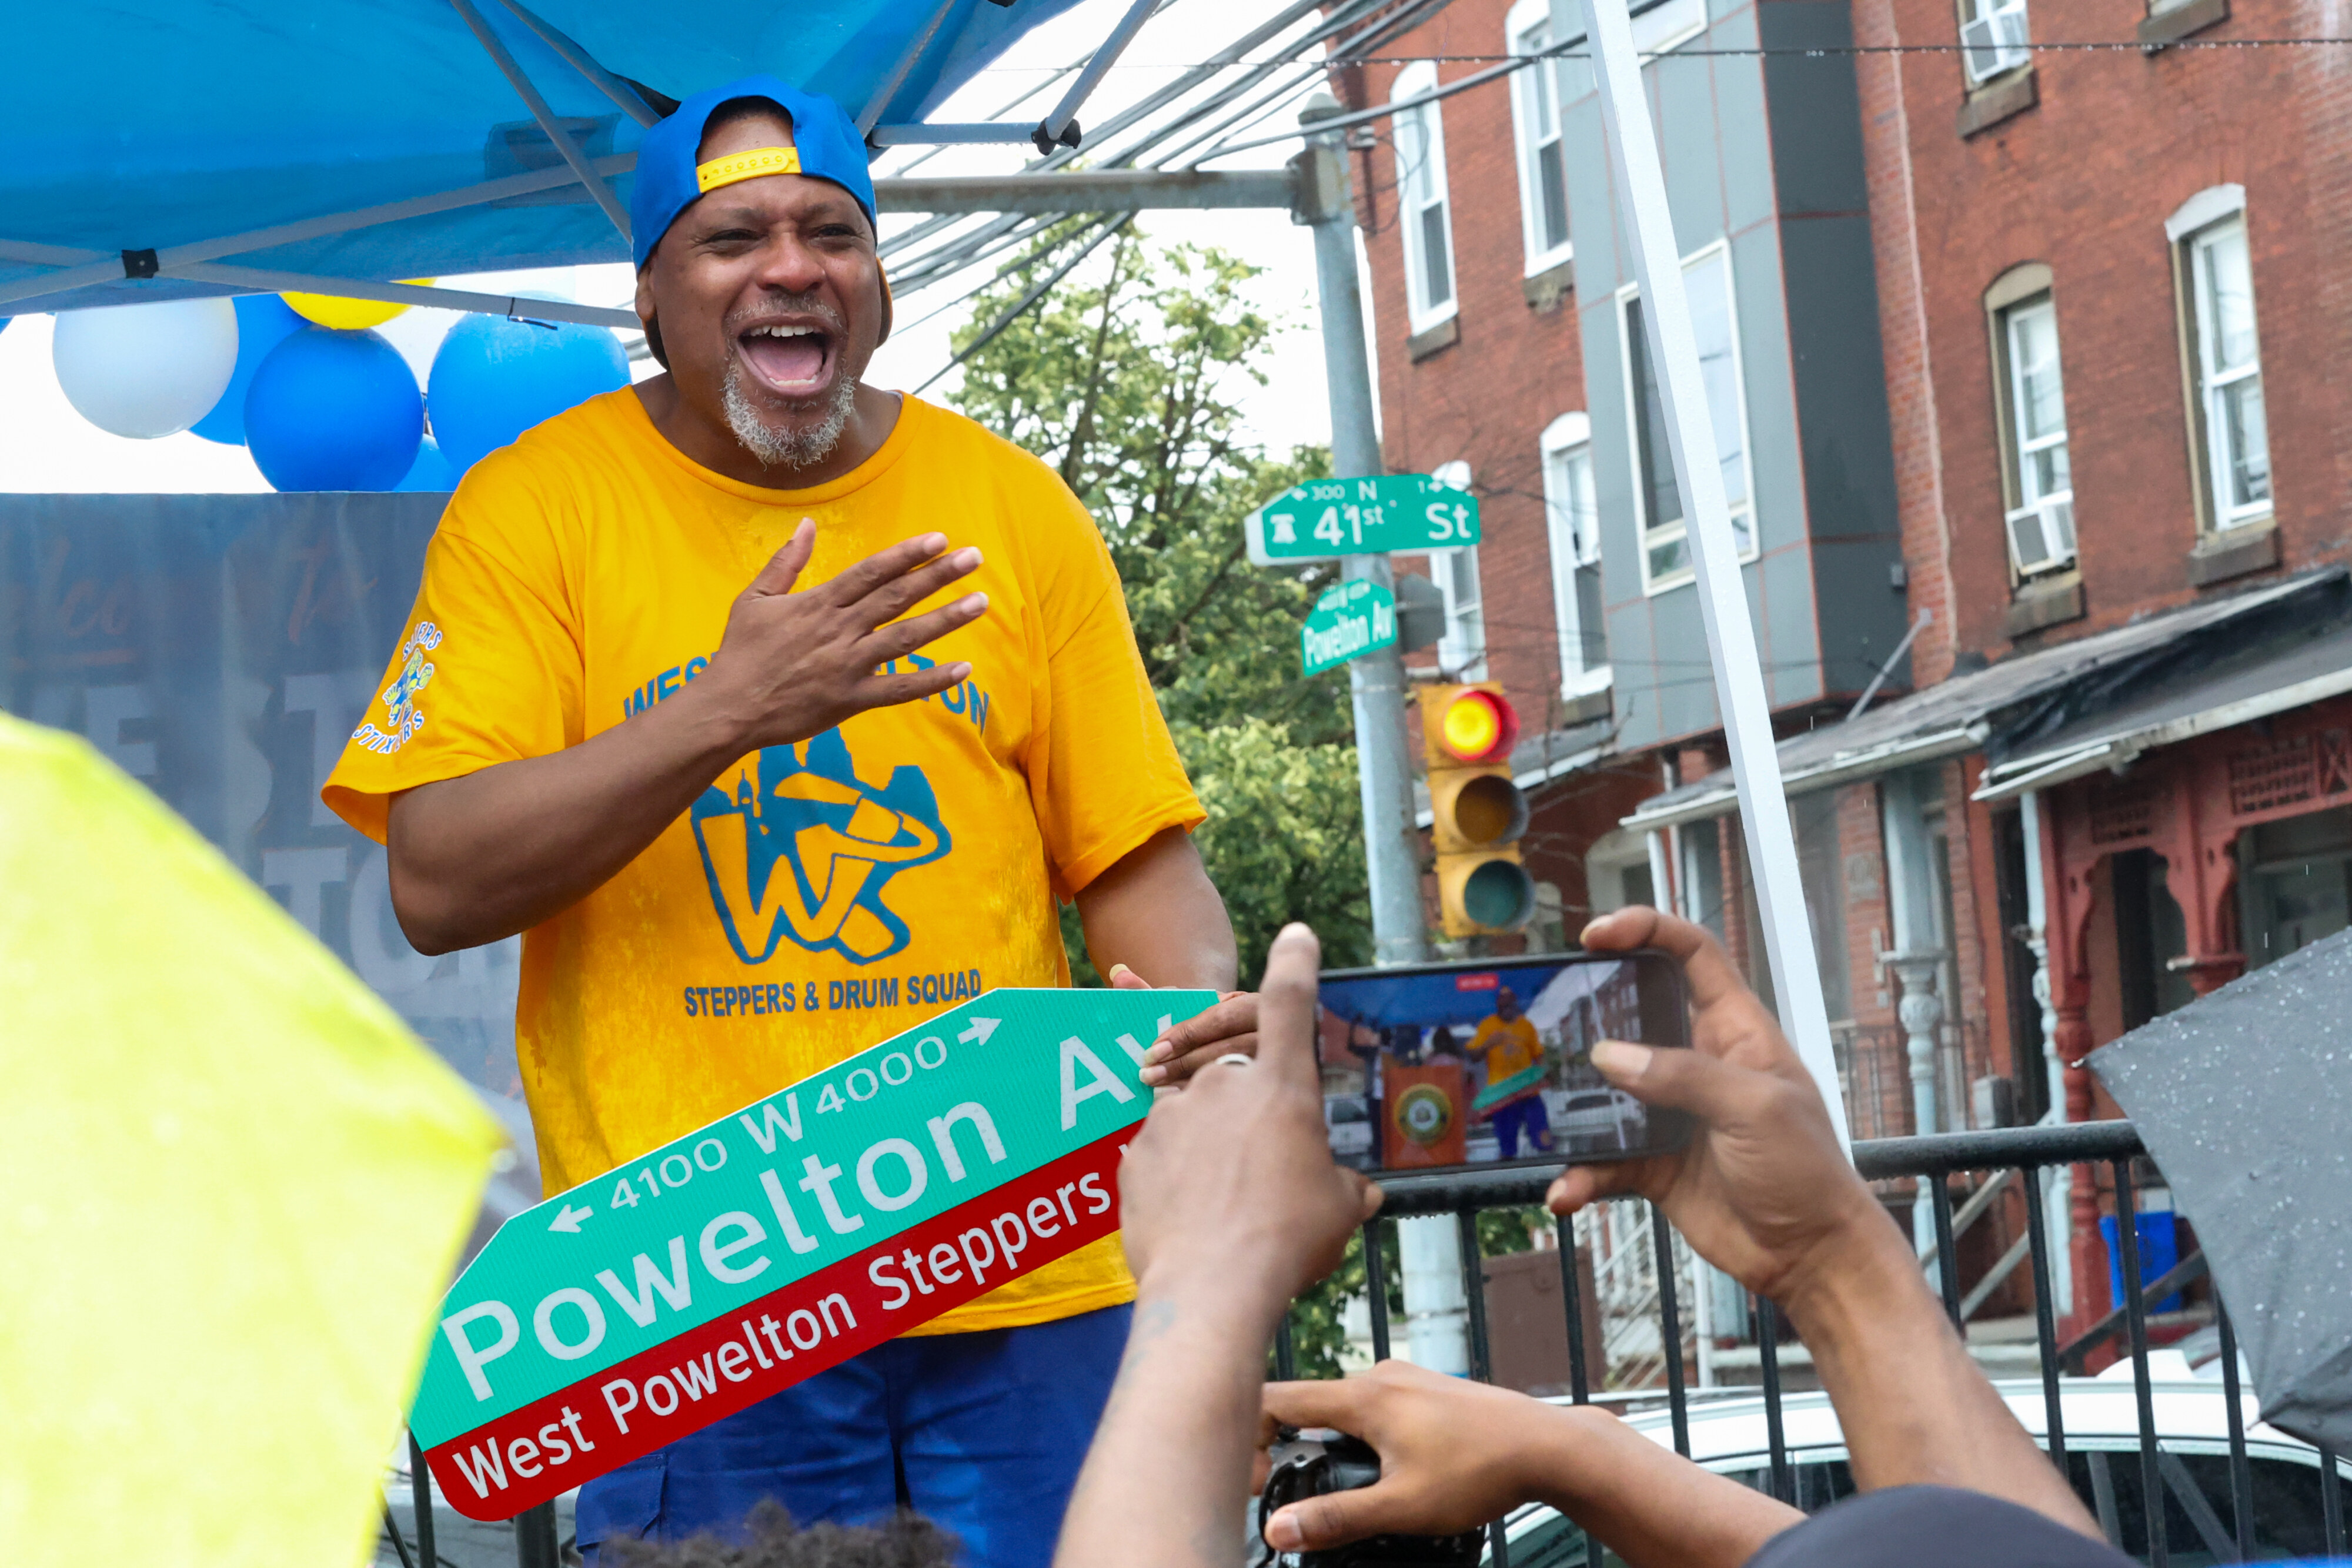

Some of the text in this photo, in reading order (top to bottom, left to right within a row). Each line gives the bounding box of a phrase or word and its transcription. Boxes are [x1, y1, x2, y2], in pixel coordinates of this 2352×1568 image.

[1358, 479, 1378, 501] N
[1313, 502, 1472, 547] 41st St
[1304, 614, 1370, 668] Powelton
[623, 651, 717, 720] WES
[684, 969, 981, 1017] STEPPERS & DRUM SQUAD
[610, 1036, 947, 1209] 4100 W 4000
[440, 1101, 1007, 1402] Powelton
[452, 1172, 1111, 1500] West Powelton Steppers
